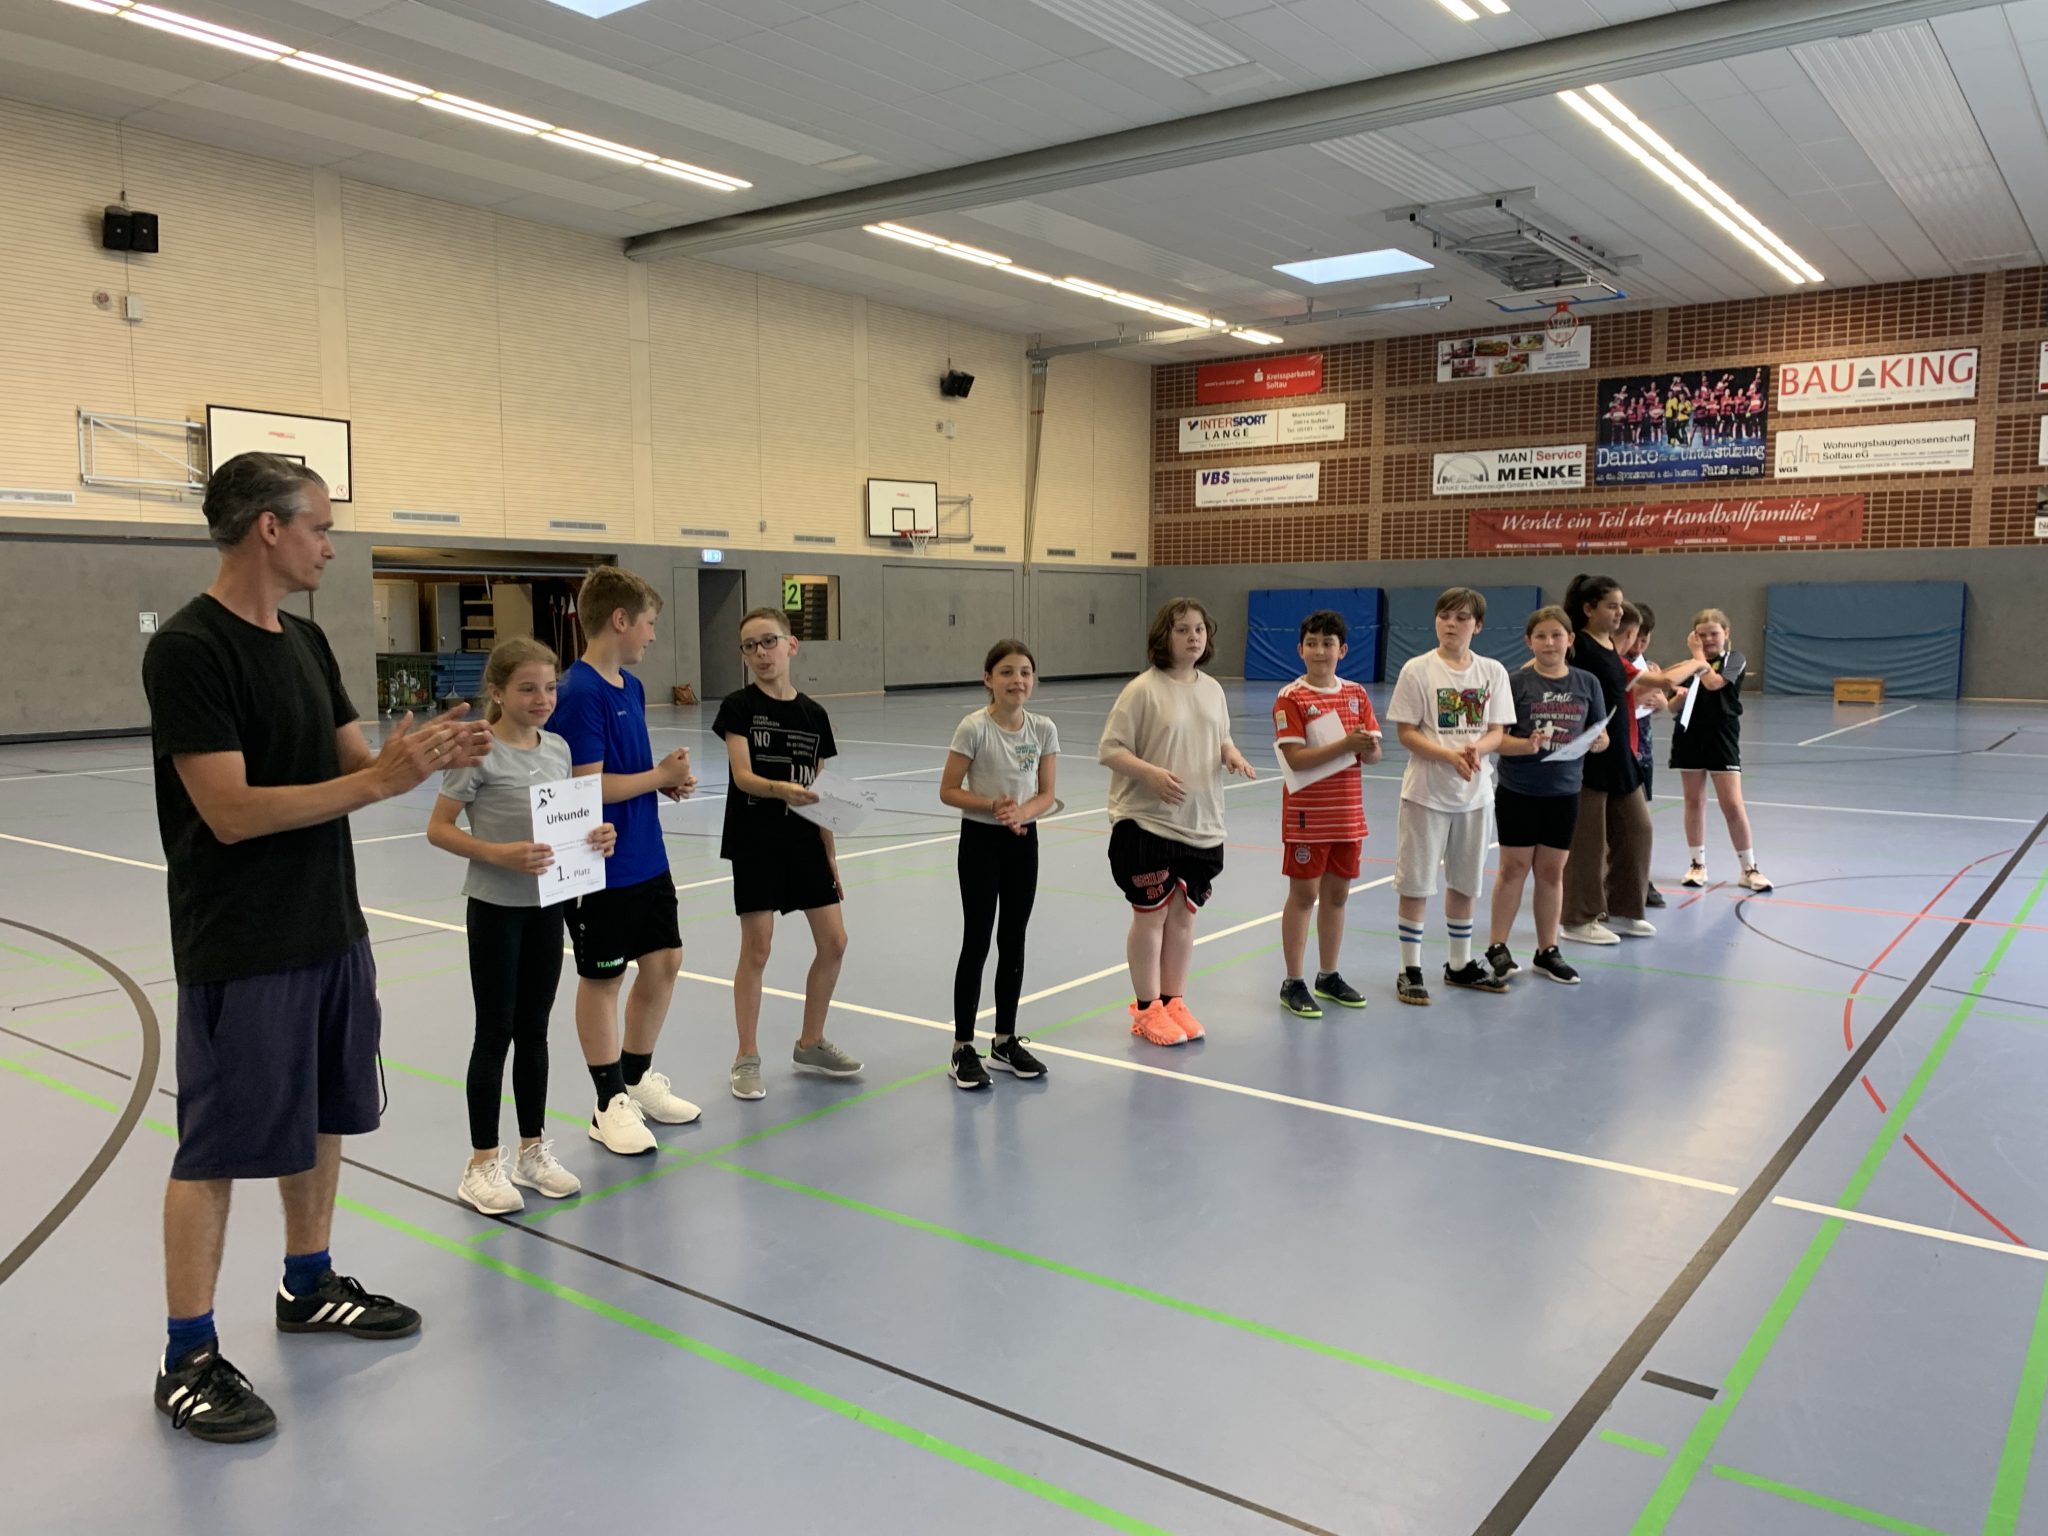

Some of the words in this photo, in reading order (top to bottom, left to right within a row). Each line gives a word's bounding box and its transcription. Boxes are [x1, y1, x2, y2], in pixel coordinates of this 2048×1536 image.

[1266, 370, 1316, 381] Kreissparkasse
[1780, 362, 1855, 396] BAU
[1880, 352, 1974, 389] KING
[1266, 381, 1288, 390] Soltau
[1200, 414, 1267, 430] INTERSPORT
[1205, 427, 1249, 441] LANGE
[1823, 434, 1970, 450] Wohnungsbaugenossenschaft
[1498, 452, 1528, 463] MAN
[1536, 449, 1582, 461] Service
[1597, 446, 1659, 468] Danke
[1680, 443, 1765, 461] Unterstützung
[1822, 452, 1853, 461] Soltau
[1855, 450, 1869, 459] eG
[1498, 464, 1582, 481] MENKE
[1701, 463, 1728, 476] Fans
[1741, 465, 1760, 476] Liga
[1201, 471, 1230, 486] VBS
[1232, 475, 1294, 484] Versicherungsmakler
[1502, 511, 1563, 530] Werdet
[1567, 513, 1592, 529] ein
[1598, 507, 1627, 528] Teil
[1628, 506, 1659, 526] der
[1662, 500, 1820, 531] Handballfamilie!
[1681, 526, 1700, 537] seit
[1704, 525, 1731, 536] 1920
[786, 584, 799, 605] 2
[1543, 691, 1573, 703] Echte
[753, 731, 770, 748] NO
[546, 807, 590, 825] Urkunde
[556, 865, 570, 882] 1.
[573, 868, 591, 878] Platz
